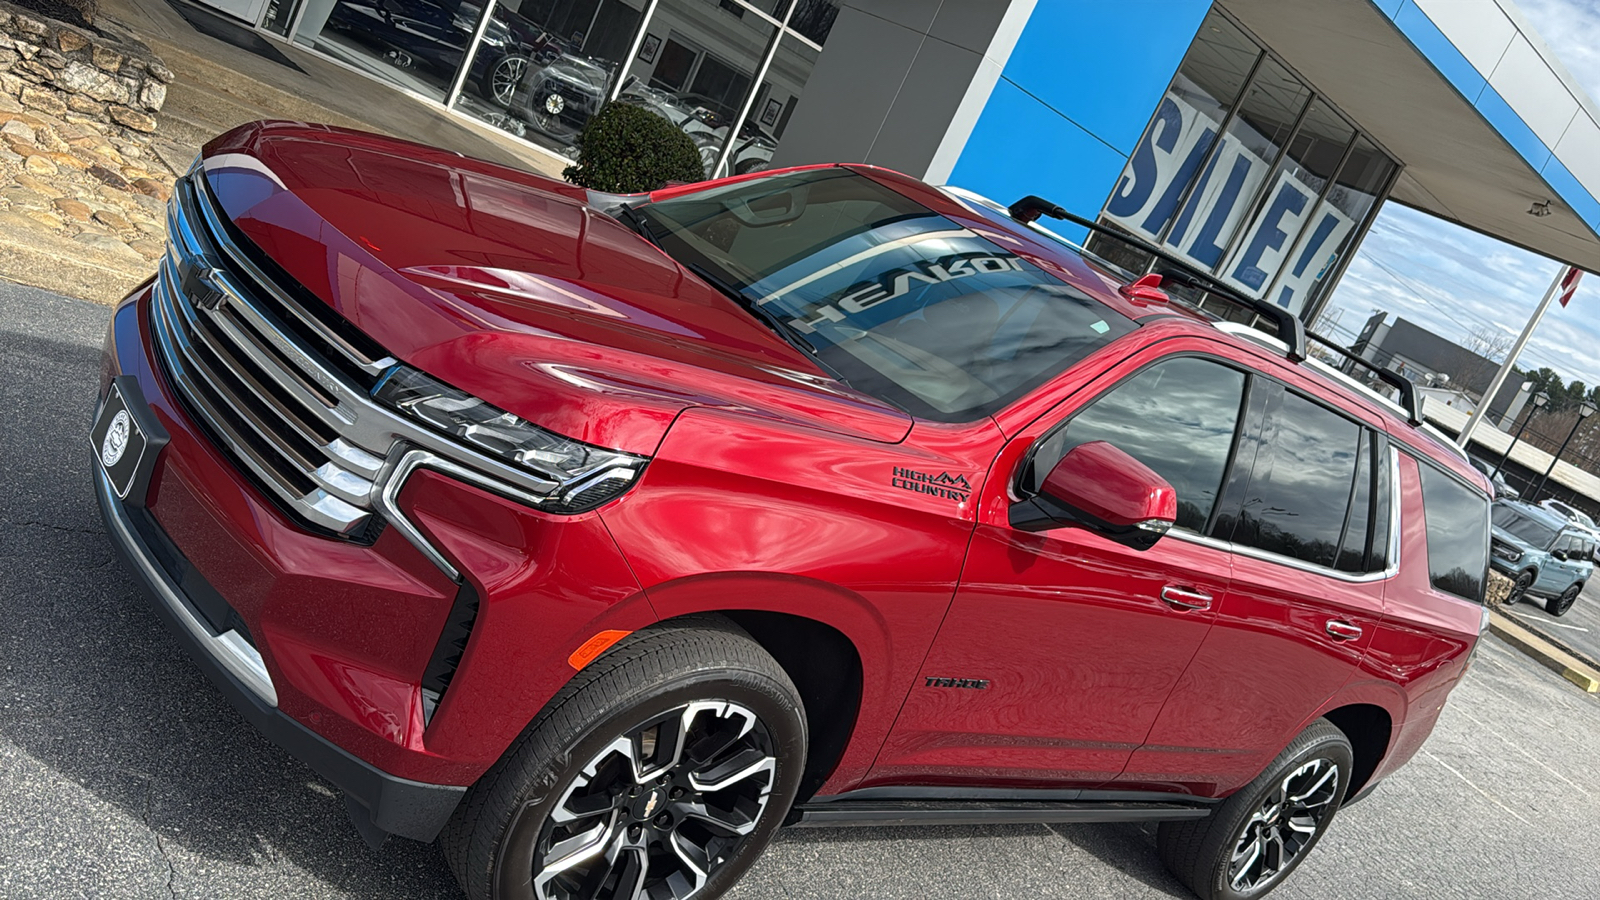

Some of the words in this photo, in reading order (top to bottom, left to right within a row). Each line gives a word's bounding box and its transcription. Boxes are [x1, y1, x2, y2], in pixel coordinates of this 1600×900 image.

[1106, 96, 1340, 309] SALE!
[892, 466, 935, 484] HIGH
[892, 477, 970, 502] COUNTRY
[925, 676, 990, 690] TAHOE
